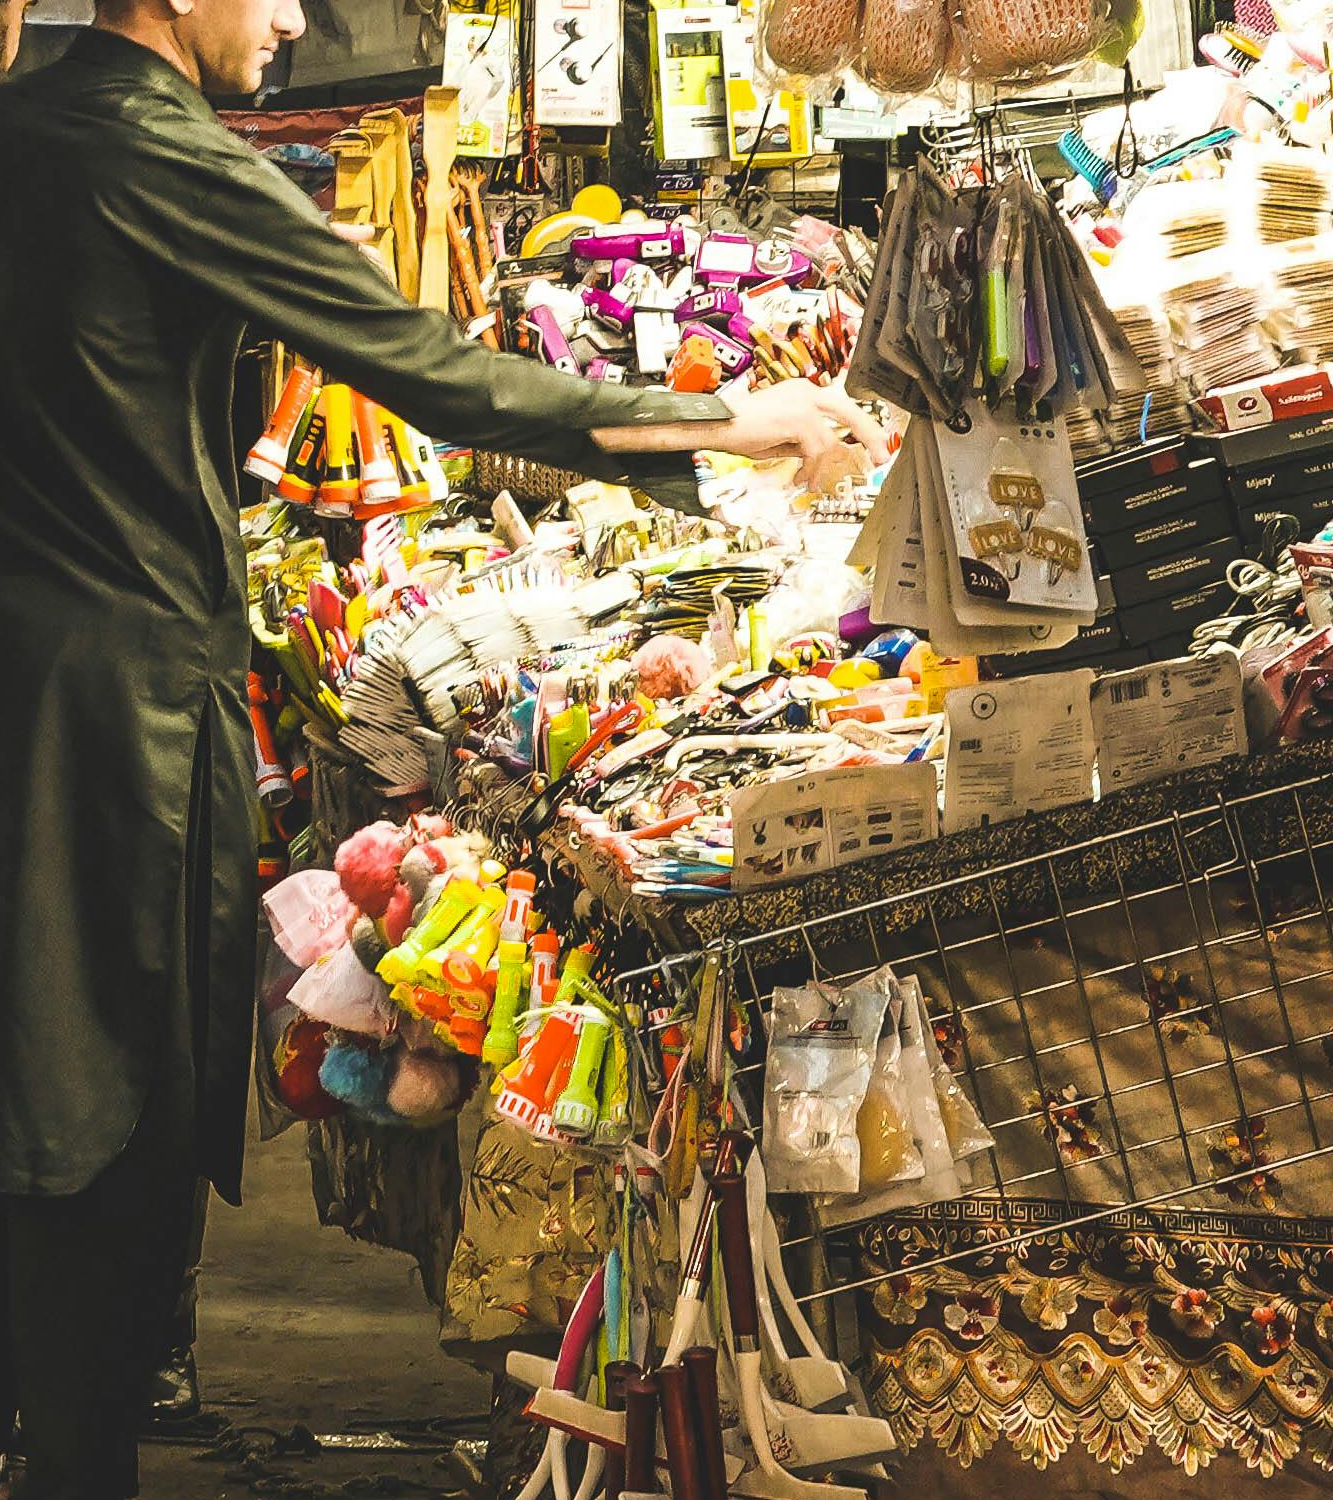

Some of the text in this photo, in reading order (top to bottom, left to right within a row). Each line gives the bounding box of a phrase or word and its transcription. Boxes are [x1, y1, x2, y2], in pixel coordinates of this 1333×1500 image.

[1000, 484, 1037, 498] LOVE
[982, 534, 1017, 550] LOVE
[1037, 535, 1076, 560] LOVE
